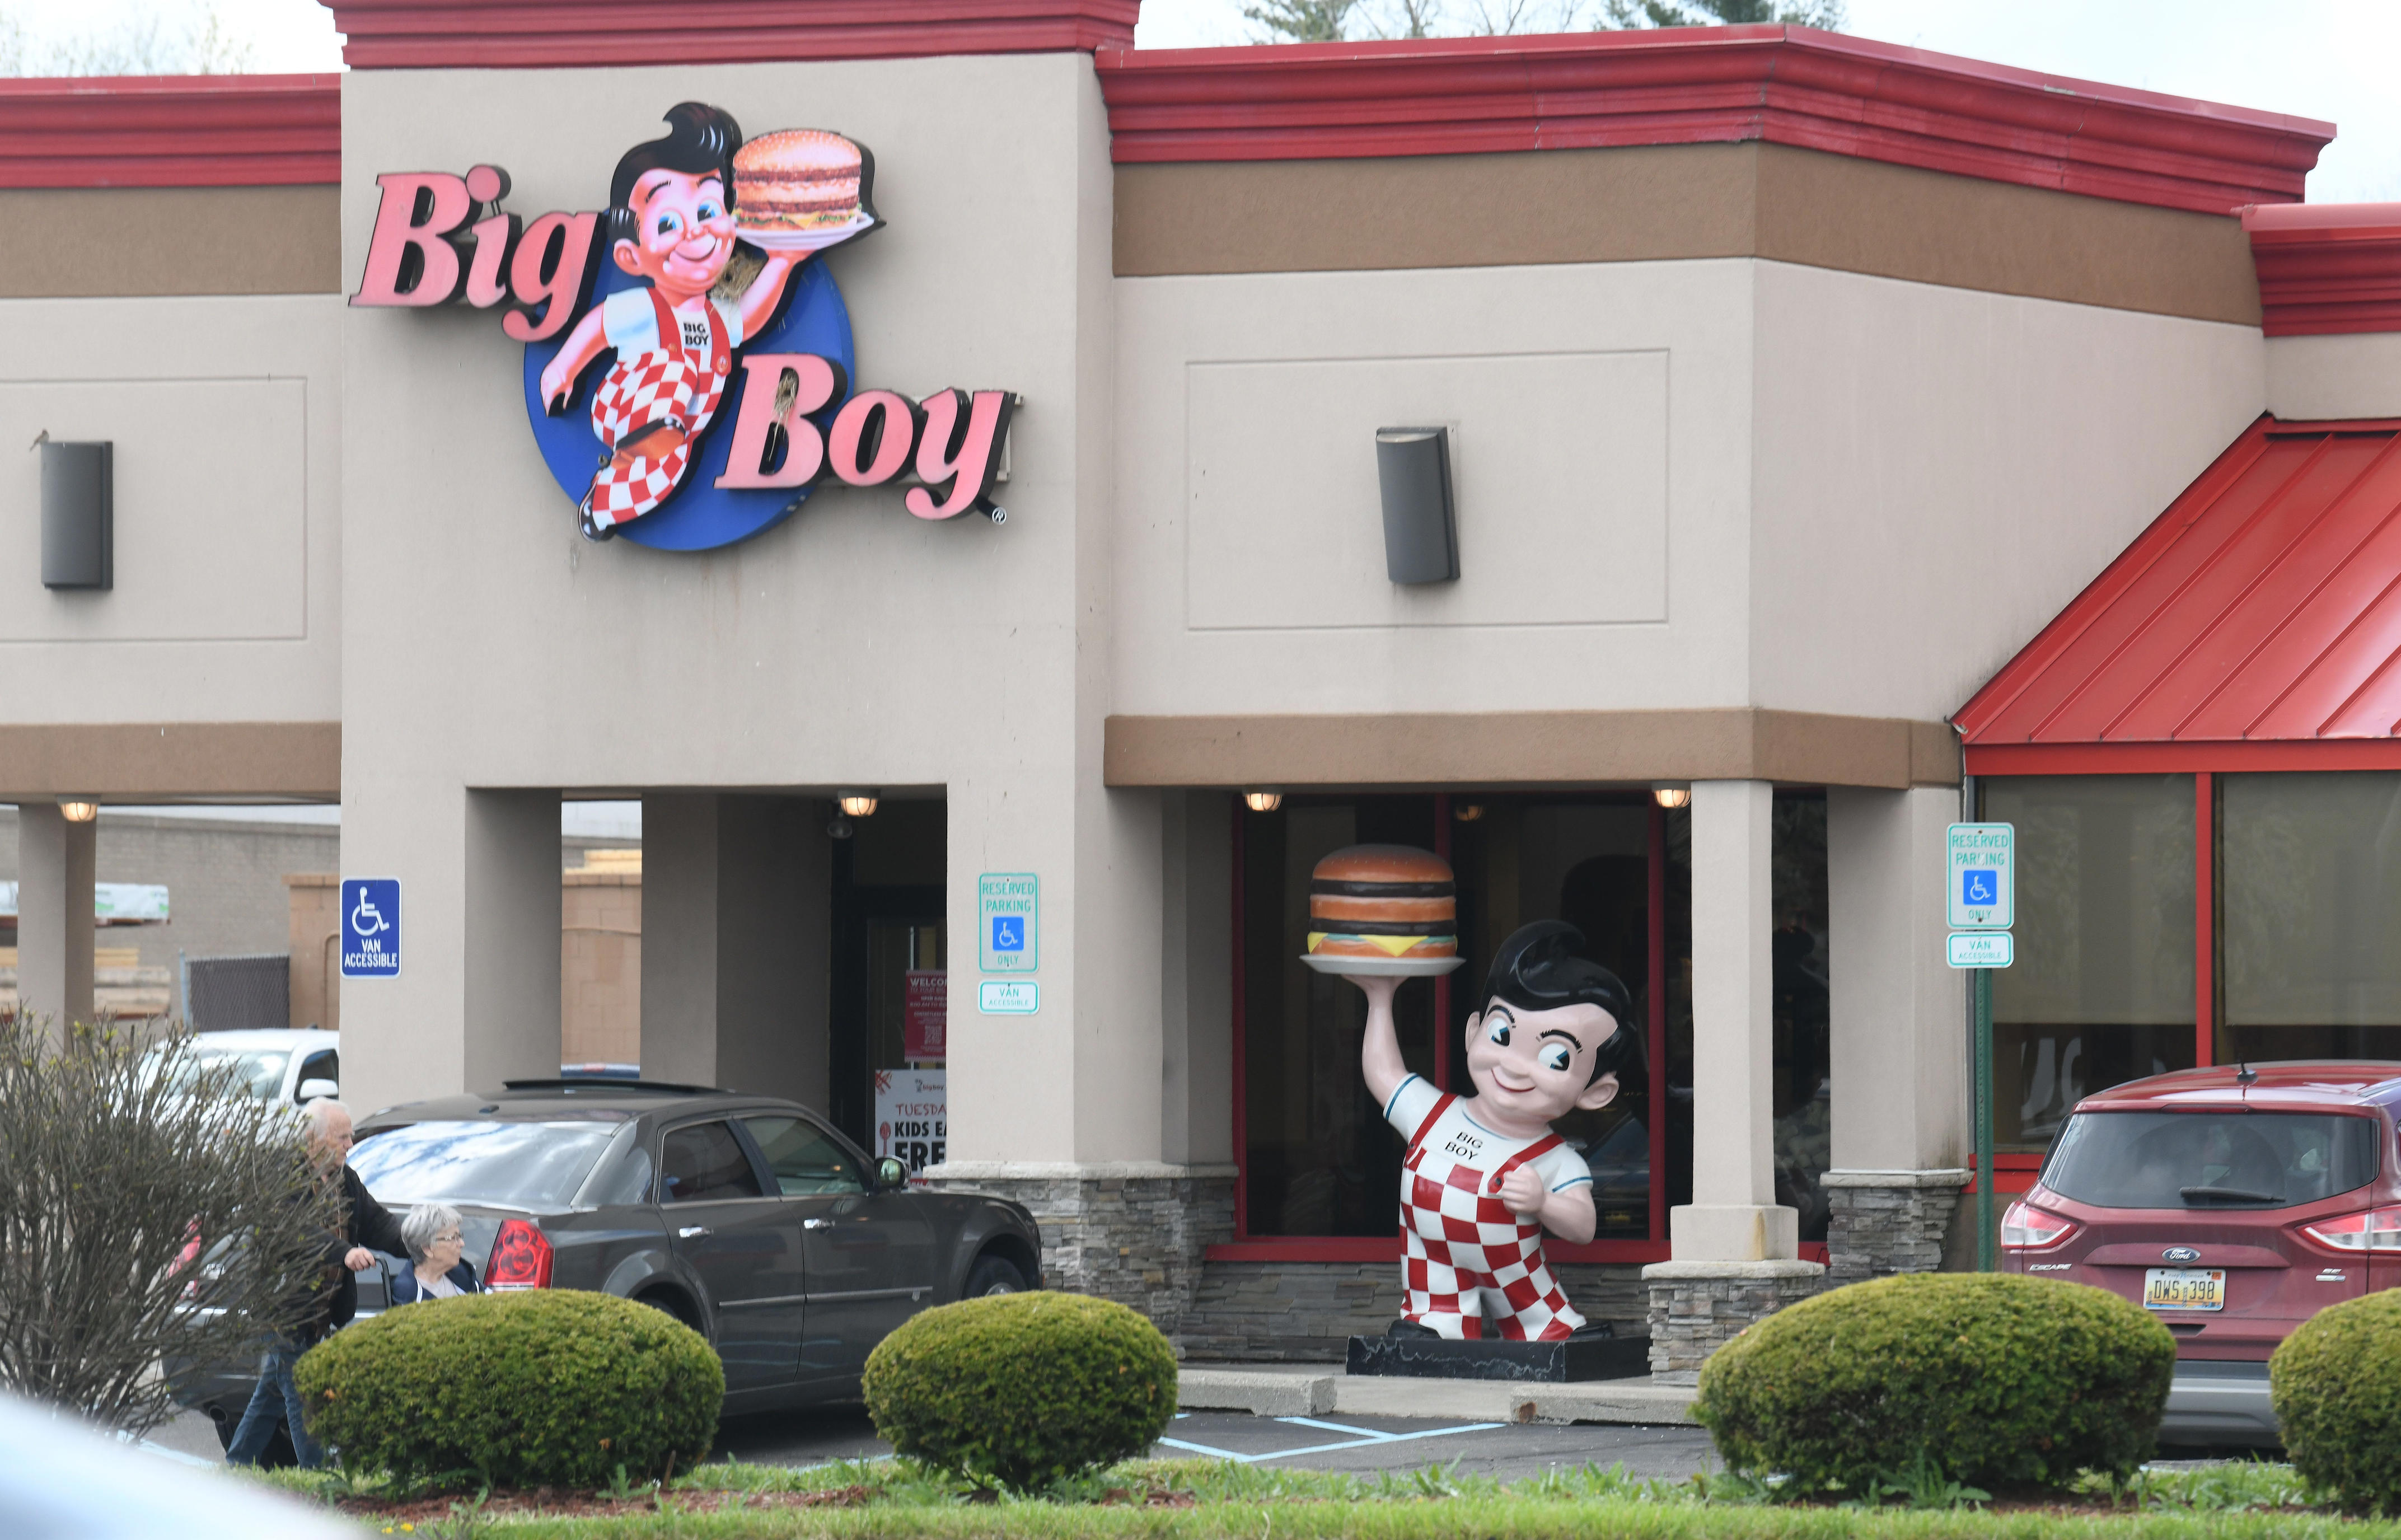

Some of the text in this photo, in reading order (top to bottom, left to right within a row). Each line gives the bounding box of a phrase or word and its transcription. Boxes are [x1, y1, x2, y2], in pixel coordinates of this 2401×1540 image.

[348, 163, 609, 341] Big
[683, 322, 706, 334] BIG
[685, 334, 709, 345] BOY
[714, 353, 1008, 521] Boy
[1952, 834, 2008, 848] RESERVED
[1956, 853, 2005, 865] PARING
[982, 882, 1035, 895] RESERVED
[986, 900, 1031, 912] PARKING
[1968, 909, 1991, 920] ONLY
[361, 938, 381, 953] VAN
[1969, 940, 1991, 950] VAN
[344, 953, 397, 968] ACCESSIBLE
[998, 955, 1019, 965] ONLY
[910, 977, 947, 986] WELCO
[1000, 988, 1019, 997] VAN
[896, 1103, 947, 1116] TUESDA
[895, 1121, 929, 1138] KIDS
[1456, 1131, 1483, 1149] BIG
[1445, 1141, 1478, 1160] BOY
[2169, 1248, 2192, 1260] Ford
[2154, 1280, 2215, 1300] DWS 398
